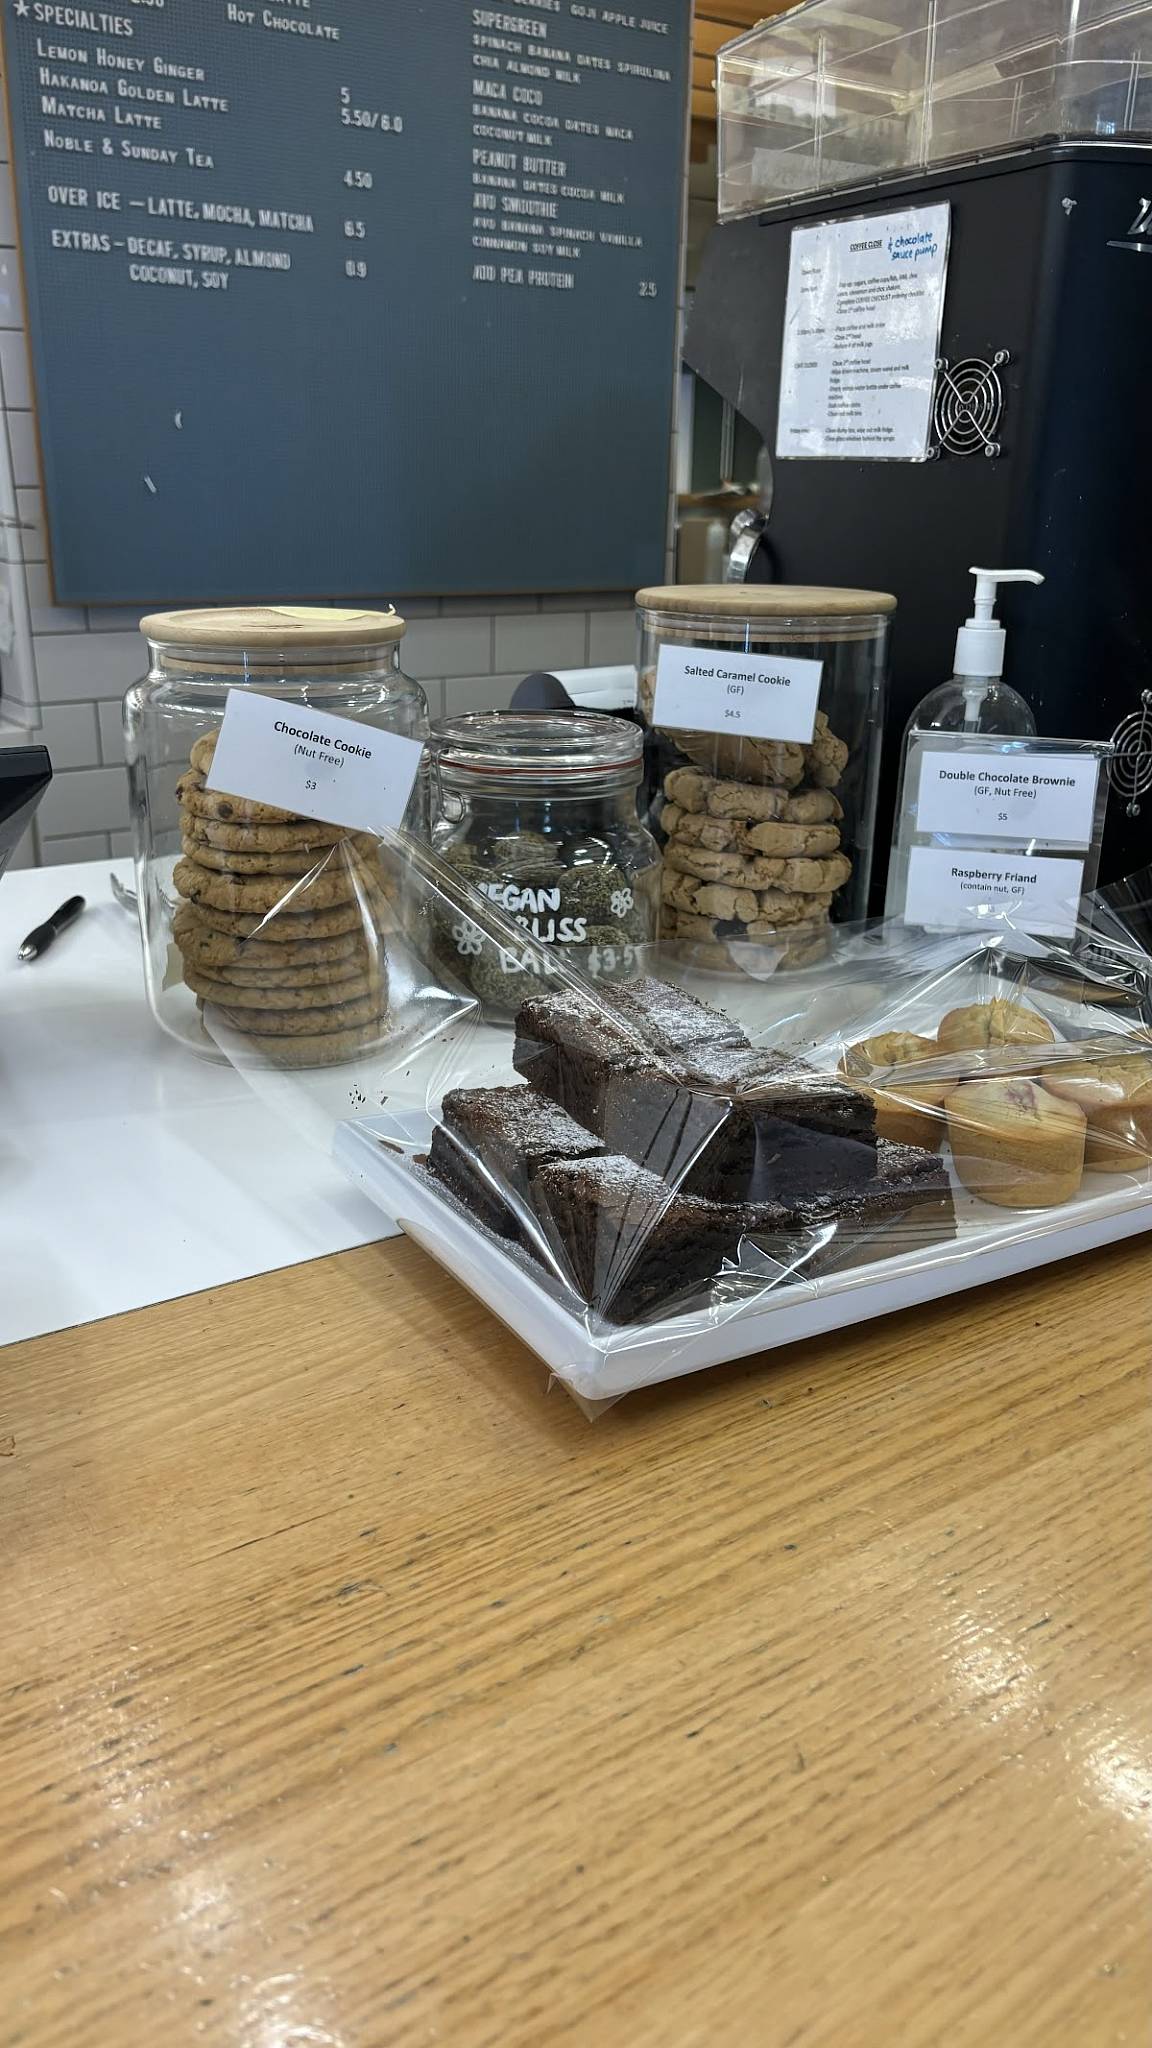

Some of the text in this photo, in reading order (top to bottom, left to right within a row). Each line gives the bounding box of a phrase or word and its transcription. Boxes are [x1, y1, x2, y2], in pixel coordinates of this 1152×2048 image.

[33, 3, 134, 36] SPECIALTIES
[472, 9, 548, 39] SUPERGREEN
[602, 10, 636, 28] APPLE
[639, 18, 669, 35] JUICE
[473, 33, 671, 82] SPINACH BANANA DATES SPIRULINA
[473, 54, 581, 84] CHIA ALMOND MILK
[340, 86, 351, 105] 5
[473, 79, 544, 106] MACA COCO
[472, 103, 518, 122] BANANA
[473, 123, 524, 142] COCONUT
[102, 137, 114, 156] &
[472, 147, 567, 178] PEANUT BUTTER
[48, 185, 89, 207] OVER
[96, 191, 121, 211] ICE
[202, 202, 256, 229] MOCHA,
[258, 208, 314, 233] MATCHA
[502, 195, 560, 219] SMOOTHIE
[52, 228, 111, 253] EXTRAS
[234, 247, 292, 271] ALMOND
[894, 232, 933, 248] chocolate
[891, 243, 938, 262] sauce pump
[129, 263, 230, 290] COCONUT, SOY
[472, 264, 575, 290] ADD PEA PROTEIN
[684, 664, 792, 687] Salted Caramel Cookie
[726, 684, 745, 697] (GF)
[724, 708, 742, 720] $4.5
[273, 721, 373, 760] Chocolate Cookie
[294, 743, 345, 769] (Nut Free)
[304, 779, 317, 791] $3
[938, 770, 1077, 788] Double Chocolate Brownie
[973, 785, 1038, 800] (GF, Nut Free)
[997, 812, 1009, 822] $5
[950, 867, 1038, 885] Raspberry Friand
[959, 883, 1026, 896] (contain nut, GF)
